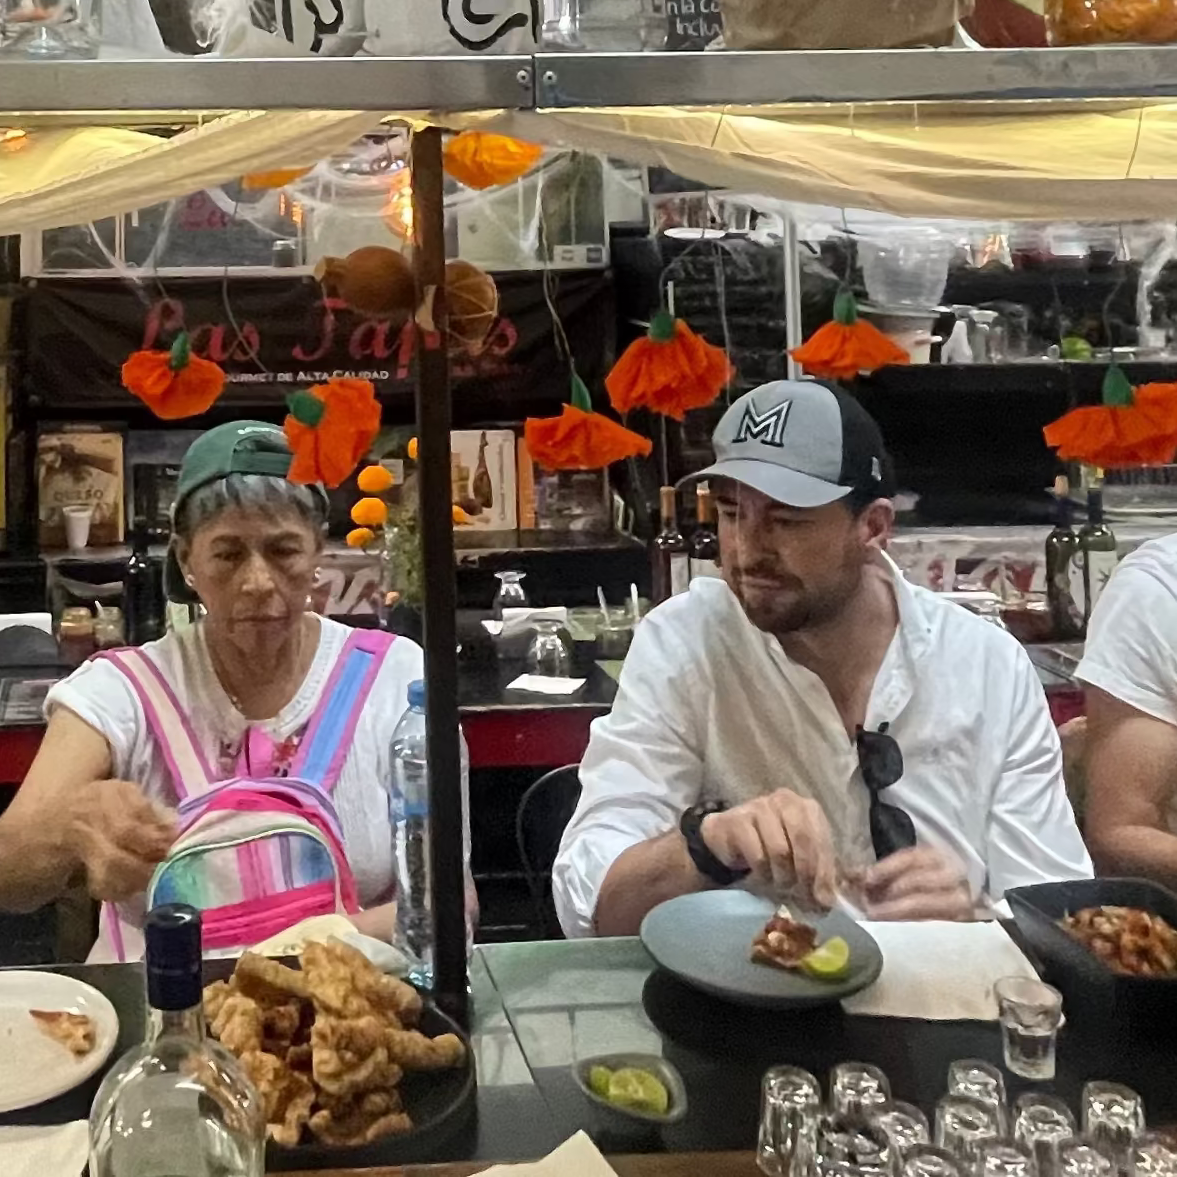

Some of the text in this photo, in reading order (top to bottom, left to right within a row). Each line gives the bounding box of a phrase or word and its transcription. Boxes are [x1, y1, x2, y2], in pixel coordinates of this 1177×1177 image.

[291, 297, 518, 379] Taps
[224, 372, 274, 383] OURMET
[731, 398, 794, 448] M
